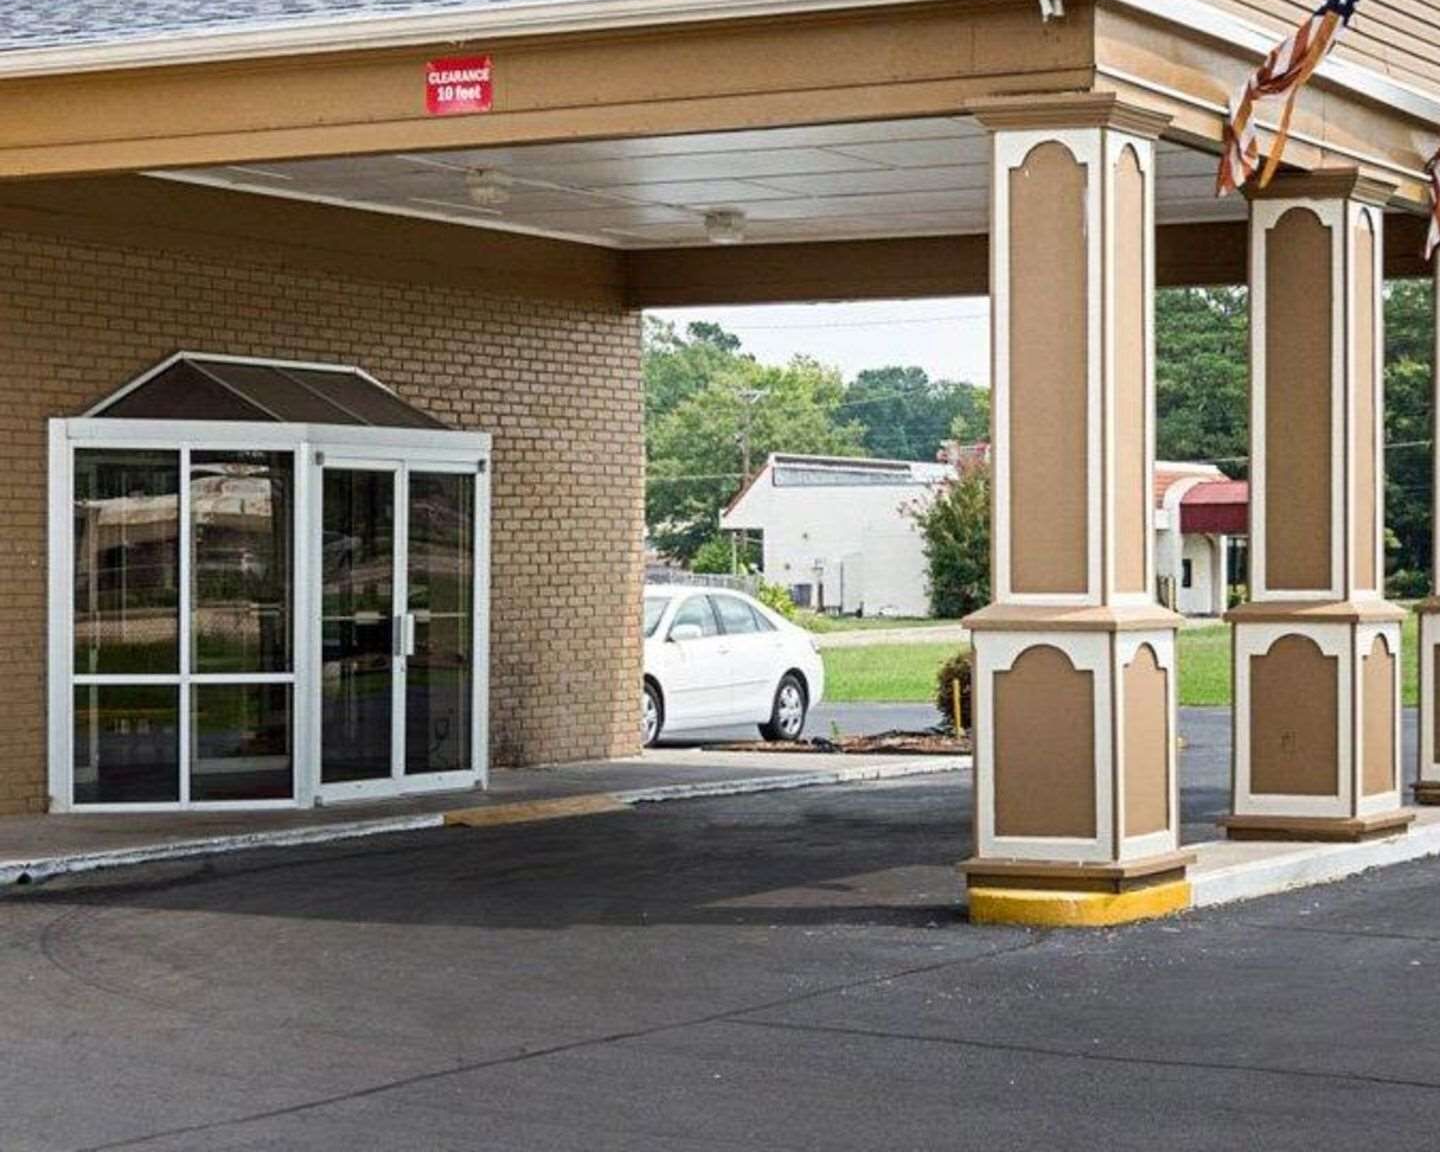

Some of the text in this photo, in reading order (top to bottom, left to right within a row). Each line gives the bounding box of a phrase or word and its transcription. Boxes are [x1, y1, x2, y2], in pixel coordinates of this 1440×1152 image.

[428, 69, 489, 84] CLEARANCE
[437, 84, 482, 102] 10 feet
